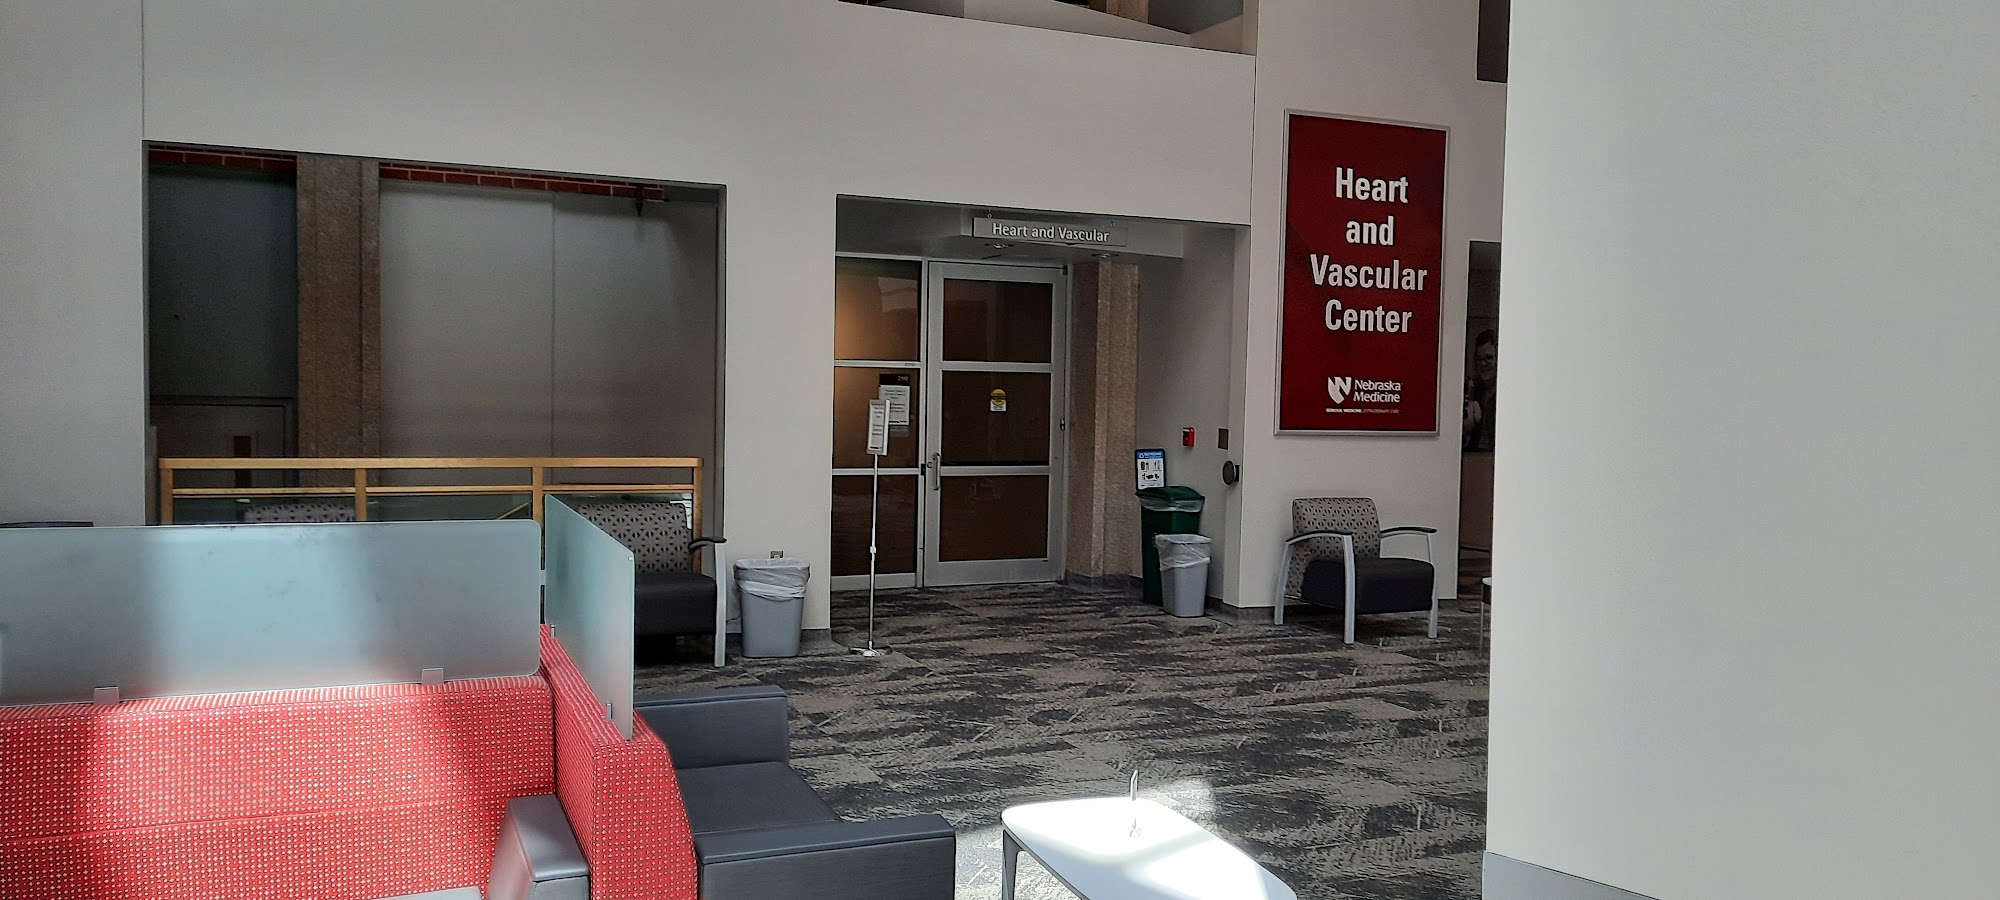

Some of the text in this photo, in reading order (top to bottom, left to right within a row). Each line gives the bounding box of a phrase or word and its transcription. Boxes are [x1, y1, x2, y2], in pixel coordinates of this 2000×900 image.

[1335, 166, 1409, 204] Heart
[992, 222, 1110, 242] Heart and Vascular
[1345, 215, 1395, 246] and
[1310, 253, 1428, 291] Vascular
[1325, 299, 1412, 333] Center
[1353, 391, 1401, 403] Medicine
[1354, 379, 1402, 391] Nebraska
